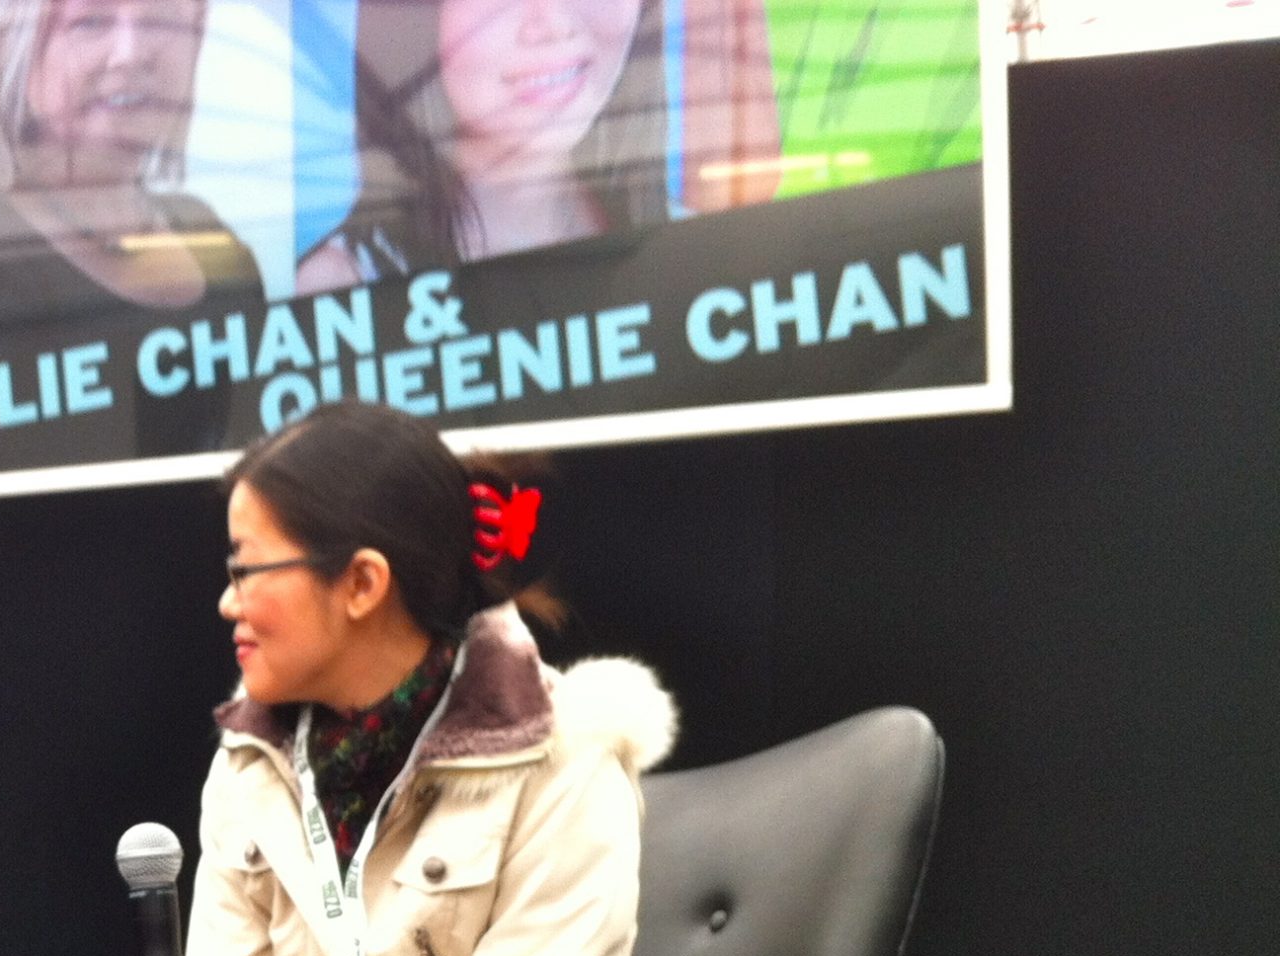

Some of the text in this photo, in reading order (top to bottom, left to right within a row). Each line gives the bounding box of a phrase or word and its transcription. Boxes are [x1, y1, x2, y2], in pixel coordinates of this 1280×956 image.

[138, 287, 376, 396] CHAN
[405, 271, 469, 344] &
[688, 245, 971, 361] CHAN
